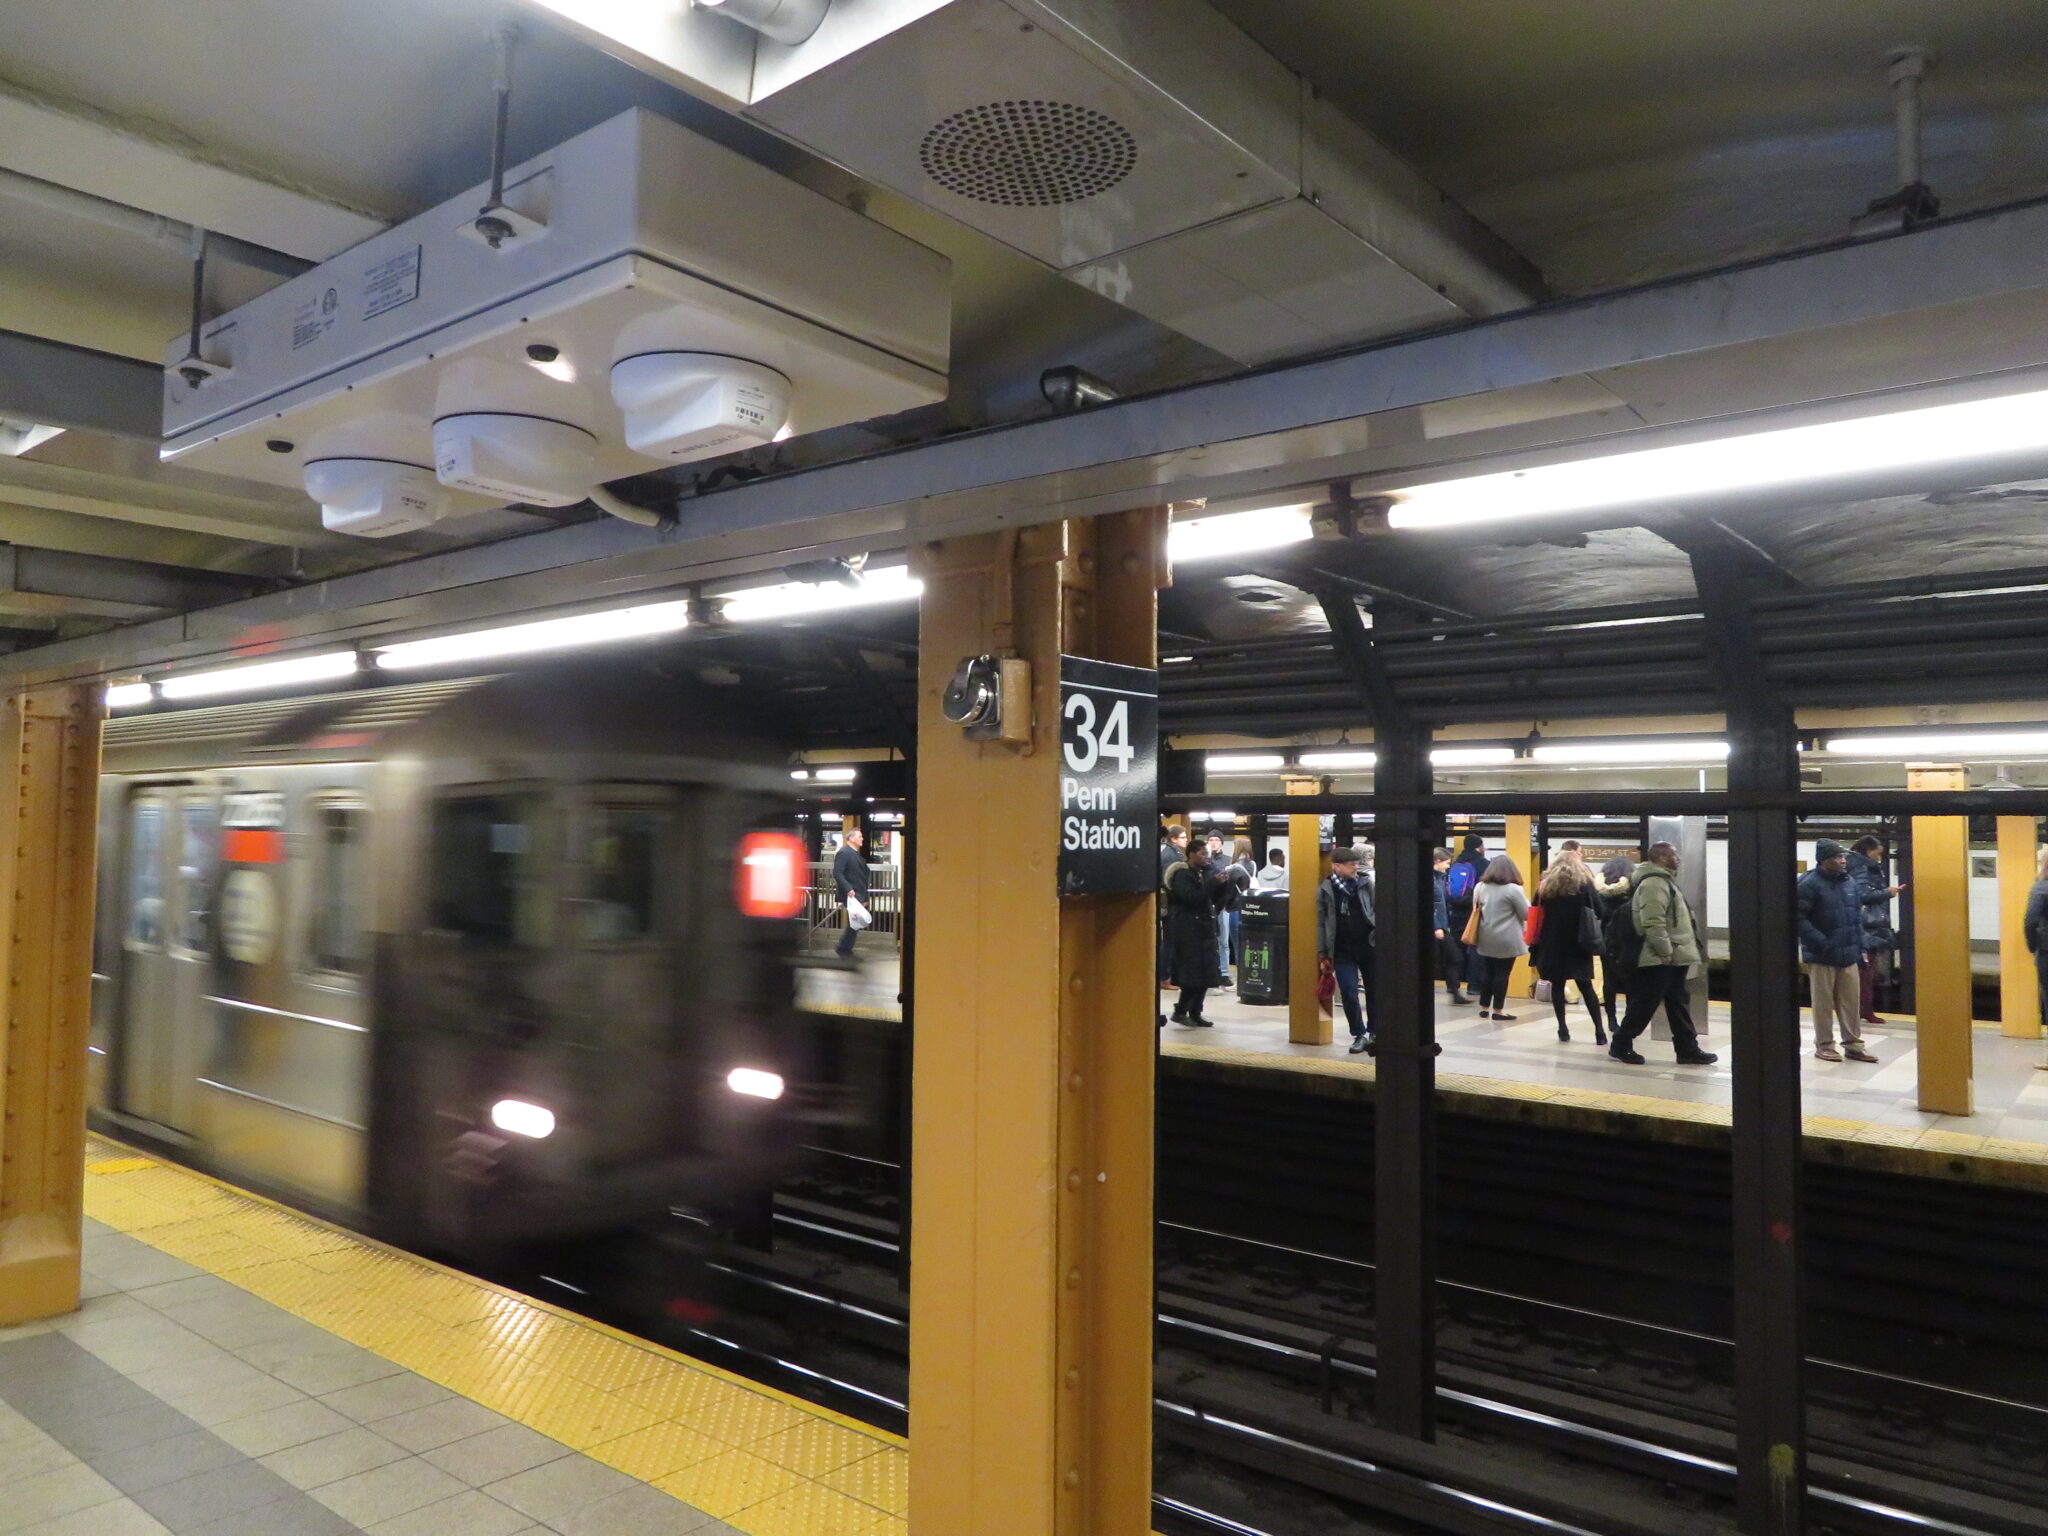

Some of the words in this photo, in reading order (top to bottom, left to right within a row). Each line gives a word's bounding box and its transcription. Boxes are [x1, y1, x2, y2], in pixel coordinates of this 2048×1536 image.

[1063, 693, 1135, 773] 34
[1063, 777, 1117, 811] Penn
[1063, 815, 1141, 851] Station
[1583, 848, 1594, 857] TO
